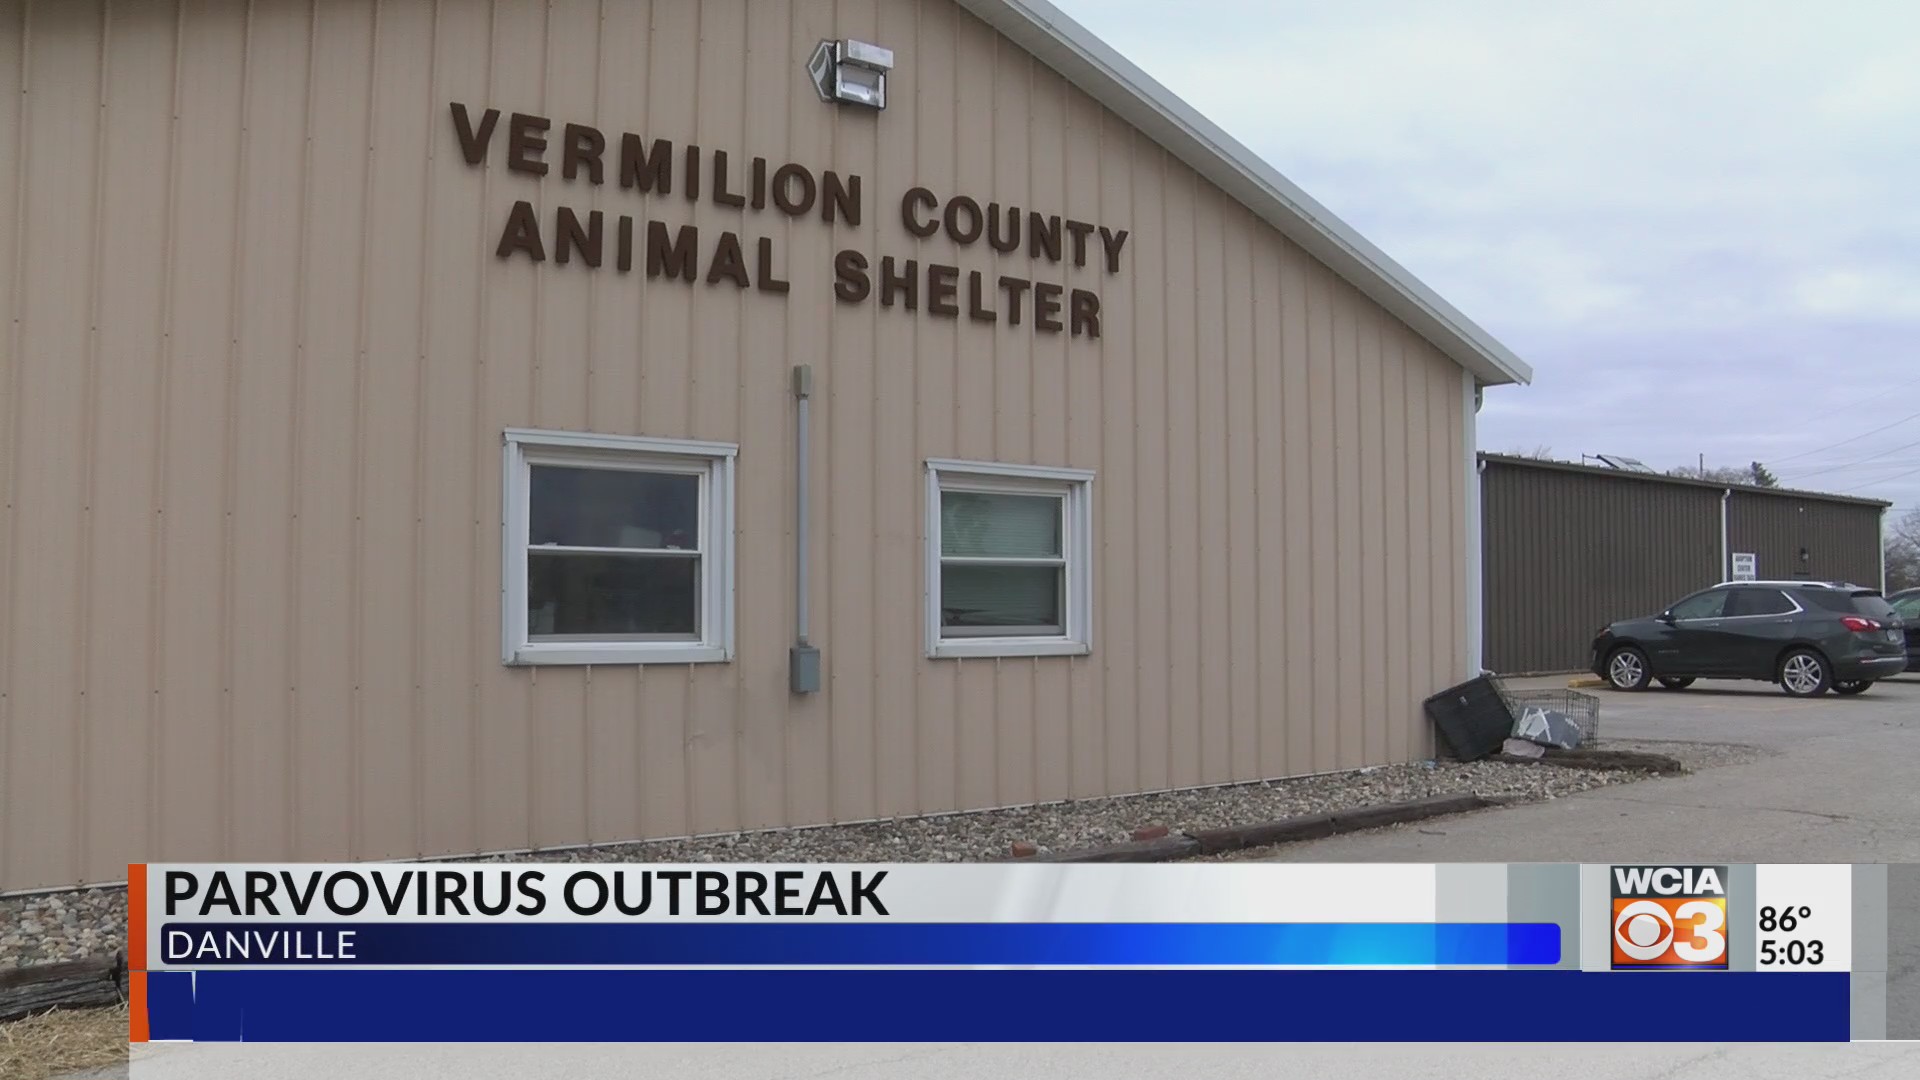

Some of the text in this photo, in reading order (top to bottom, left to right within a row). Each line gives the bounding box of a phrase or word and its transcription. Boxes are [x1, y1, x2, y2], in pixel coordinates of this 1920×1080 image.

[450, 101, 1129, 273] VERMILION COUNTY
[496, 200, 1101, 338] ANIMAL SHELTER
